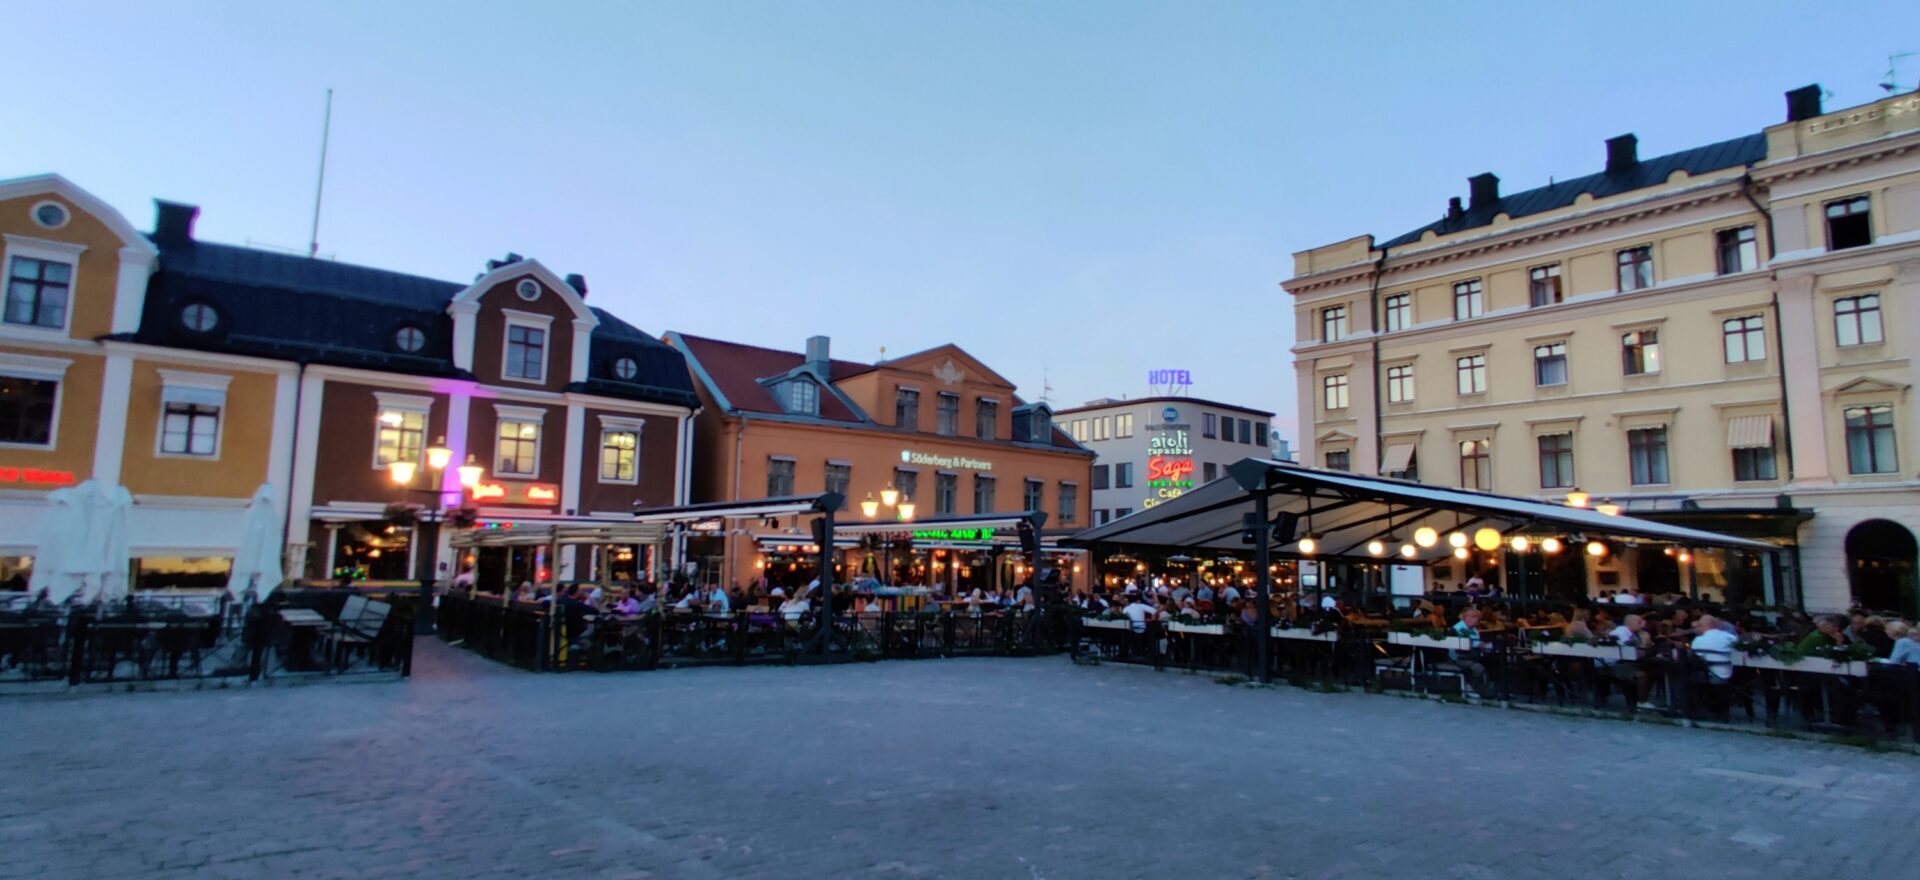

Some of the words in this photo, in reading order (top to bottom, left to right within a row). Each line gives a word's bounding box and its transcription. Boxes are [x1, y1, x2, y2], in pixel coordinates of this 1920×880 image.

[1149, 369, 1193, 385] HOTEL
[1151, 430, 1188, 448] aioli
[1147, 445, 1193, 457] tapasbar
[911, 453, 953, 469] Söderberg
[953, 457, 960, 468] &
[960, 458, 992, 470] Partners
[1147, 456, 1193, 482] Saga
